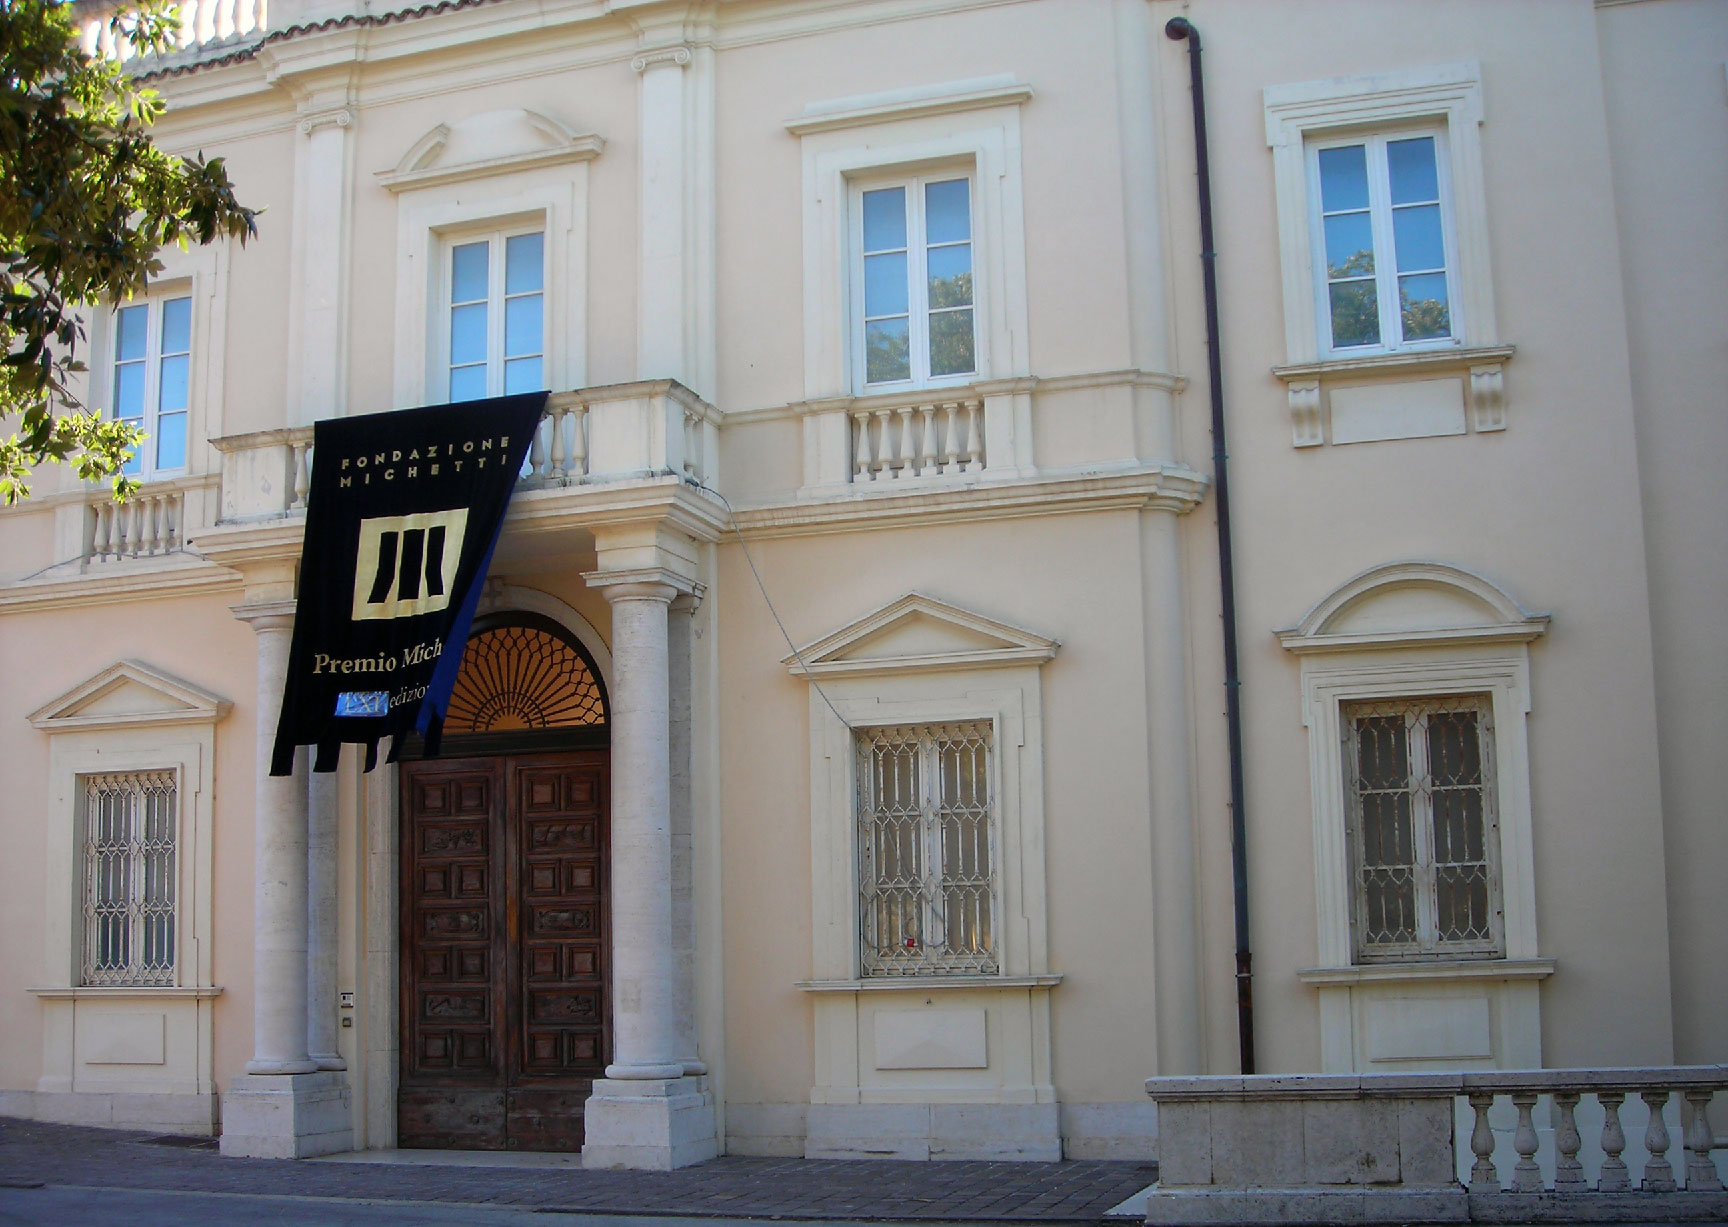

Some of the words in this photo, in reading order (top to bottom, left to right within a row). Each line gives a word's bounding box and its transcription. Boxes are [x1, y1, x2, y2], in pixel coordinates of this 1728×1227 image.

[341, 436, 509, 470] FONDAZIONE
[340, 454, 506, 487] MICHETTI
[312, 651, 397, 674] Premio
[389, 682, 430, 709] edizio
